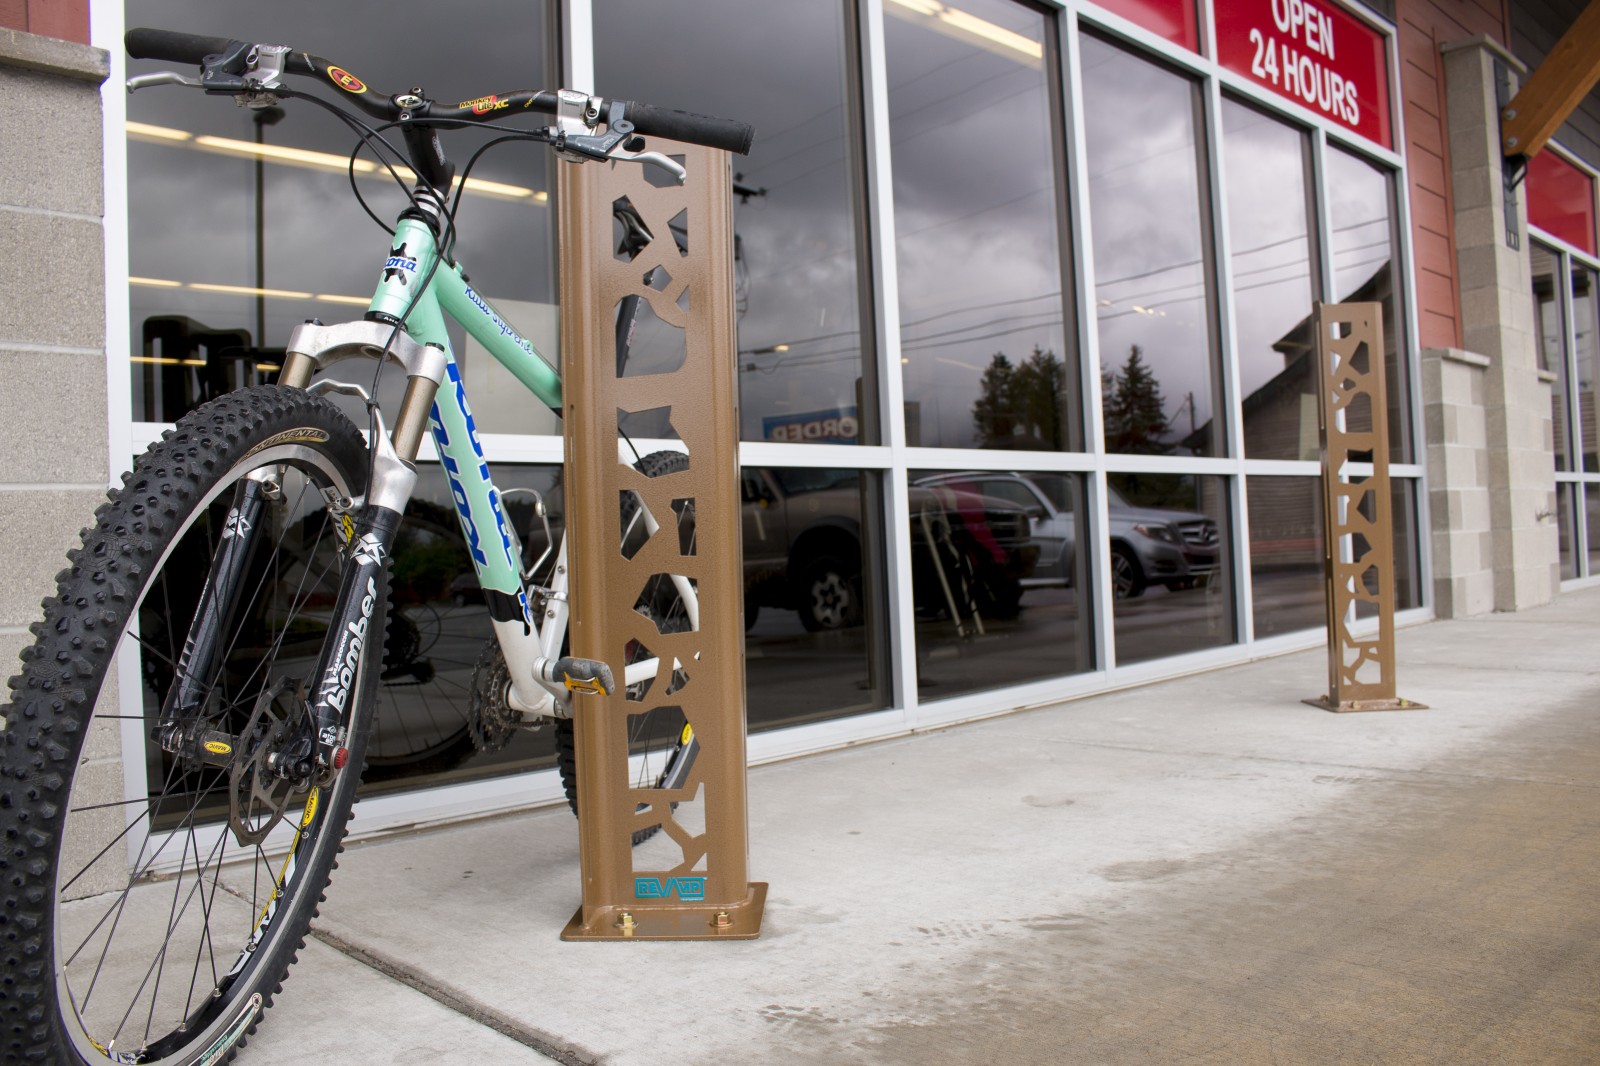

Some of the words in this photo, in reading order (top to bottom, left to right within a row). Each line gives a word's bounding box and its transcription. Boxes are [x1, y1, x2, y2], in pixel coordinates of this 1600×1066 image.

[1271, 0, 1335, 61] OPEN
[1249, 27, 1279, 85] 24
[1281, 43, 1359, 126] HOURS
